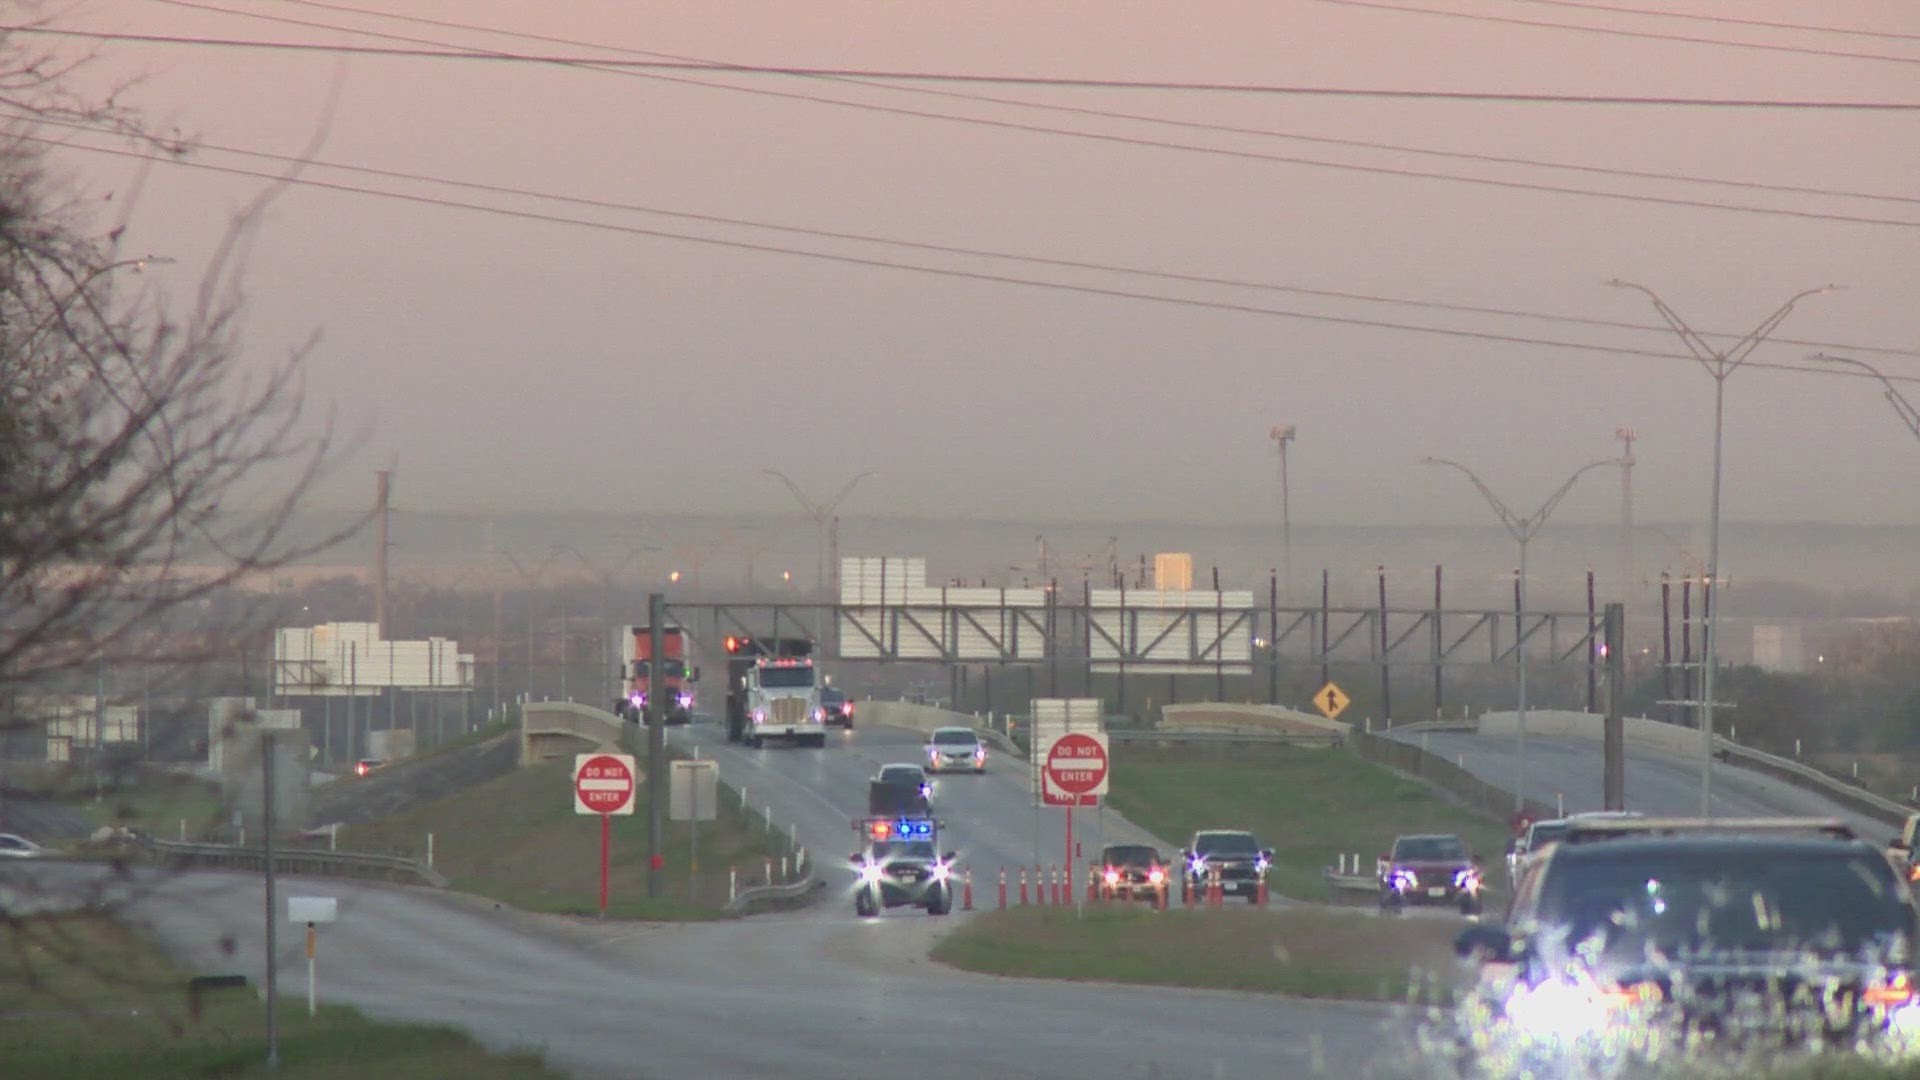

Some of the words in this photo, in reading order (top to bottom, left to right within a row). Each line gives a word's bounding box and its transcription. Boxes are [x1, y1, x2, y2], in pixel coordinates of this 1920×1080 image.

[1057, 746, 1072, 756] DO
[1077, 746, 1097, 756] NOT
[586, 767, 600, 777] DO
[604, 767, 623, 777] NOT
[1061, 771, 1093, 782] ENTER
[589, 792, 619, 802] ENTER
